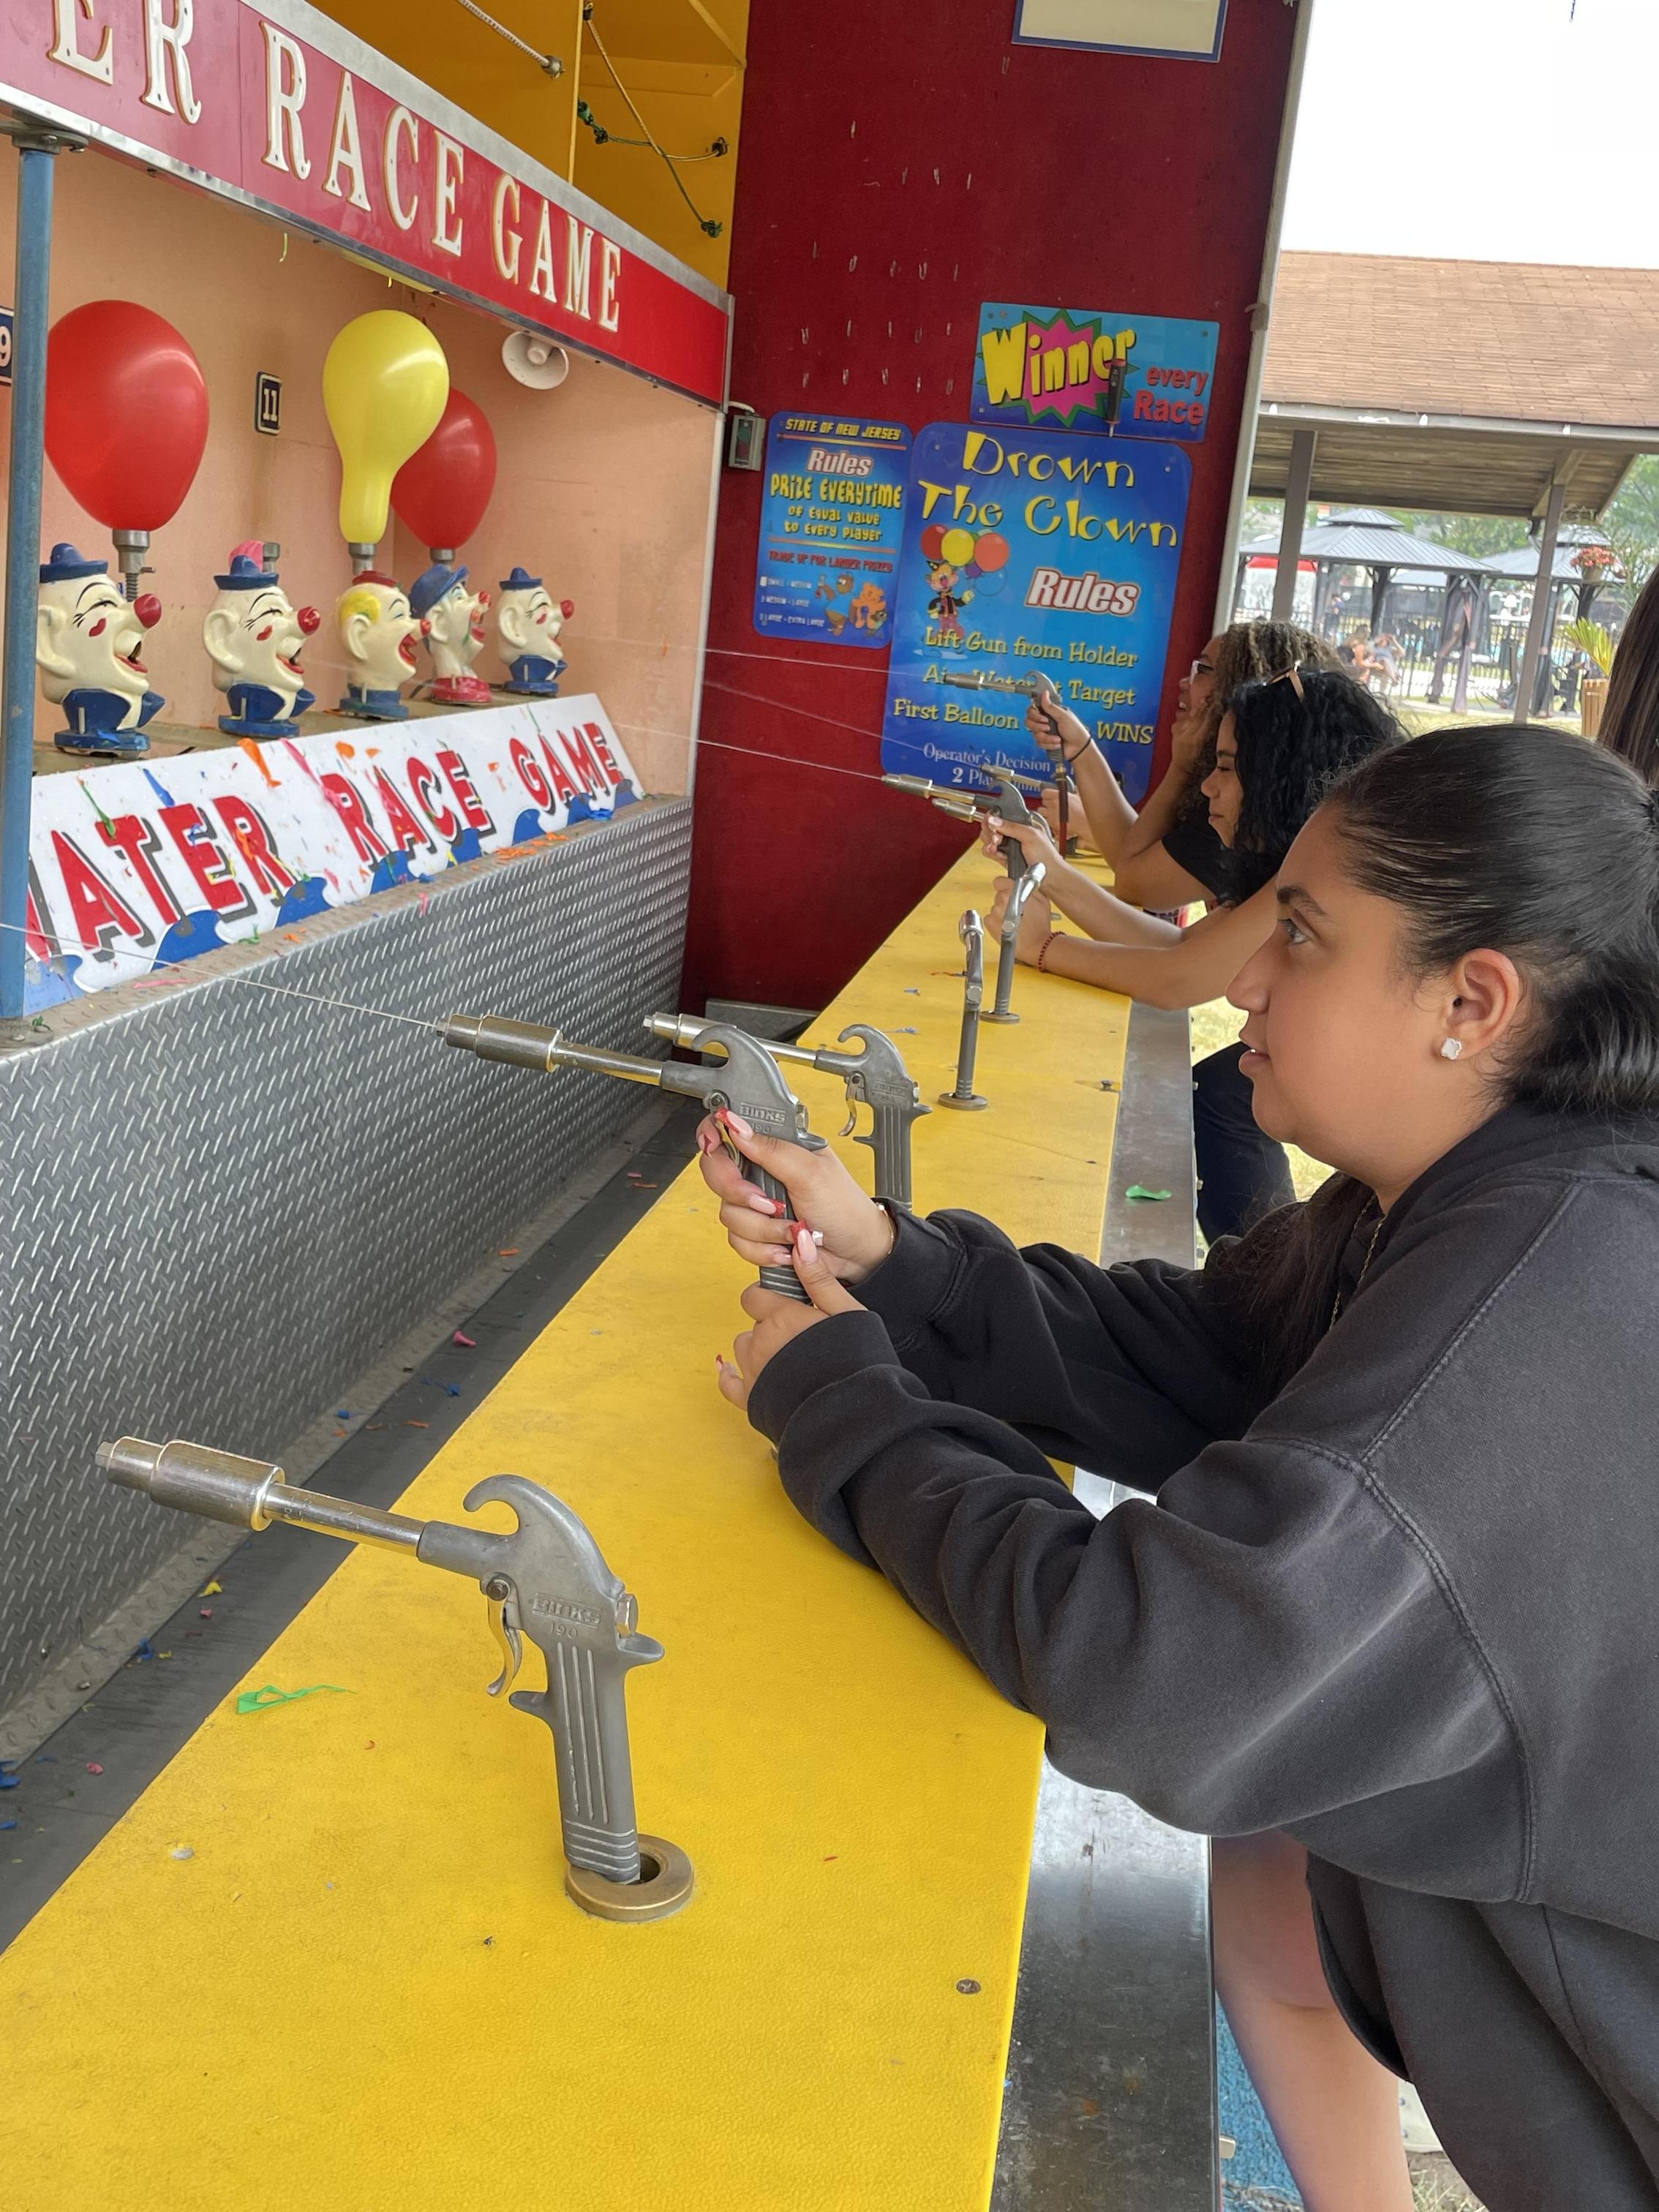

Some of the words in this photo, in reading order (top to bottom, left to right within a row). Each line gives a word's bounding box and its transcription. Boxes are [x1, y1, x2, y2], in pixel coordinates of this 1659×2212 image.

[261, 20, 464, 256] RACE
[492, 173, 622, 333] GAME
[0, 326, 12, 366] 9
[981, 322, 1136, 404] Winner
[1147, 366, 1208, 396] every
[263, 388, 278, 421] 11
[1134, 390, 1204, 425] Race
[785, 418, 818, 432] STATE
[819, 421, 834, 434] OF
[835, 424, 859, 437] NEW
[862, 426, 901, 440] JERSEY
[807, 448, 873, 476] Rules
[963, 431, 1135, 488] Drown
[918, 480, 1003, 527] The
[1026, 495, 1177, 547] Clown
[1027, 569, 1139, 614] Rules
[925, 626, 961, 650] Lift
[965, 633, 1007, 655] Gun
[1014, 639, 1062, 661] from
[1069, 642, 1137, 668] Holder
[1069, 678, 1135, 709] Target
[894, 698, 938, 721] First
[944, 703, 1019, 729] Balloon
[1097, 721, 1154, 745] WINS
[923, 742, 991, 766] Operator's
[996, 750, 1050, 772] Decision
[952, 767, 963, 783] 2
[26, 796, 300, 964] ATER
[321, 750, 490, 863] RACE
[508, 722, 624, 808] GAME
[550, 1622, 579, 1639] 190
